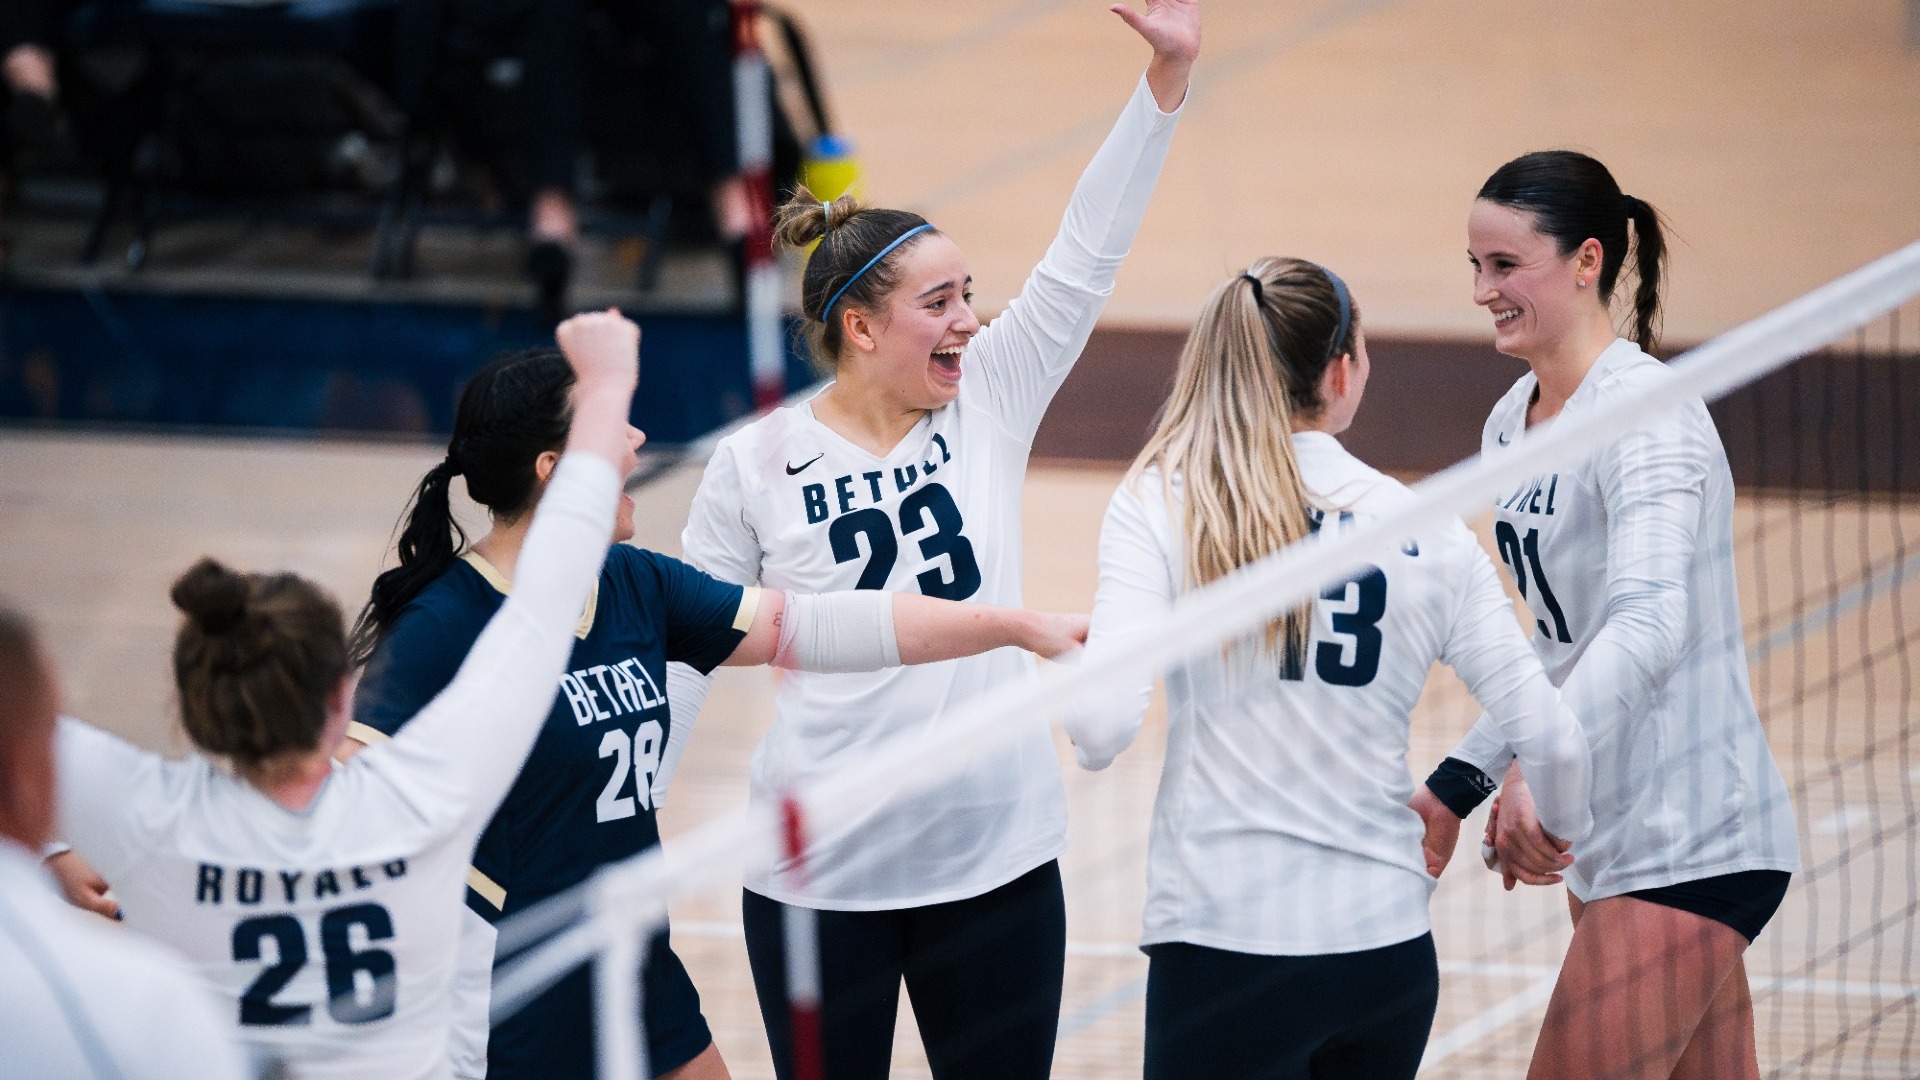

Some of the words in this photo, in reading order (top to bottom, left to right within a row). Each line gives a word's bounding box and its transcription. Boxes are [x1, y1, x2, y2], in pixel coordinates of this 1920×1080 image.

[829, 482, 982, 602] 23
[1496, 520, 1573, 644] 21
[559, 657, 666, 727] BETHEL
[596, 719, 663, 823] 28
[231, 901, 395, 1026] 26
